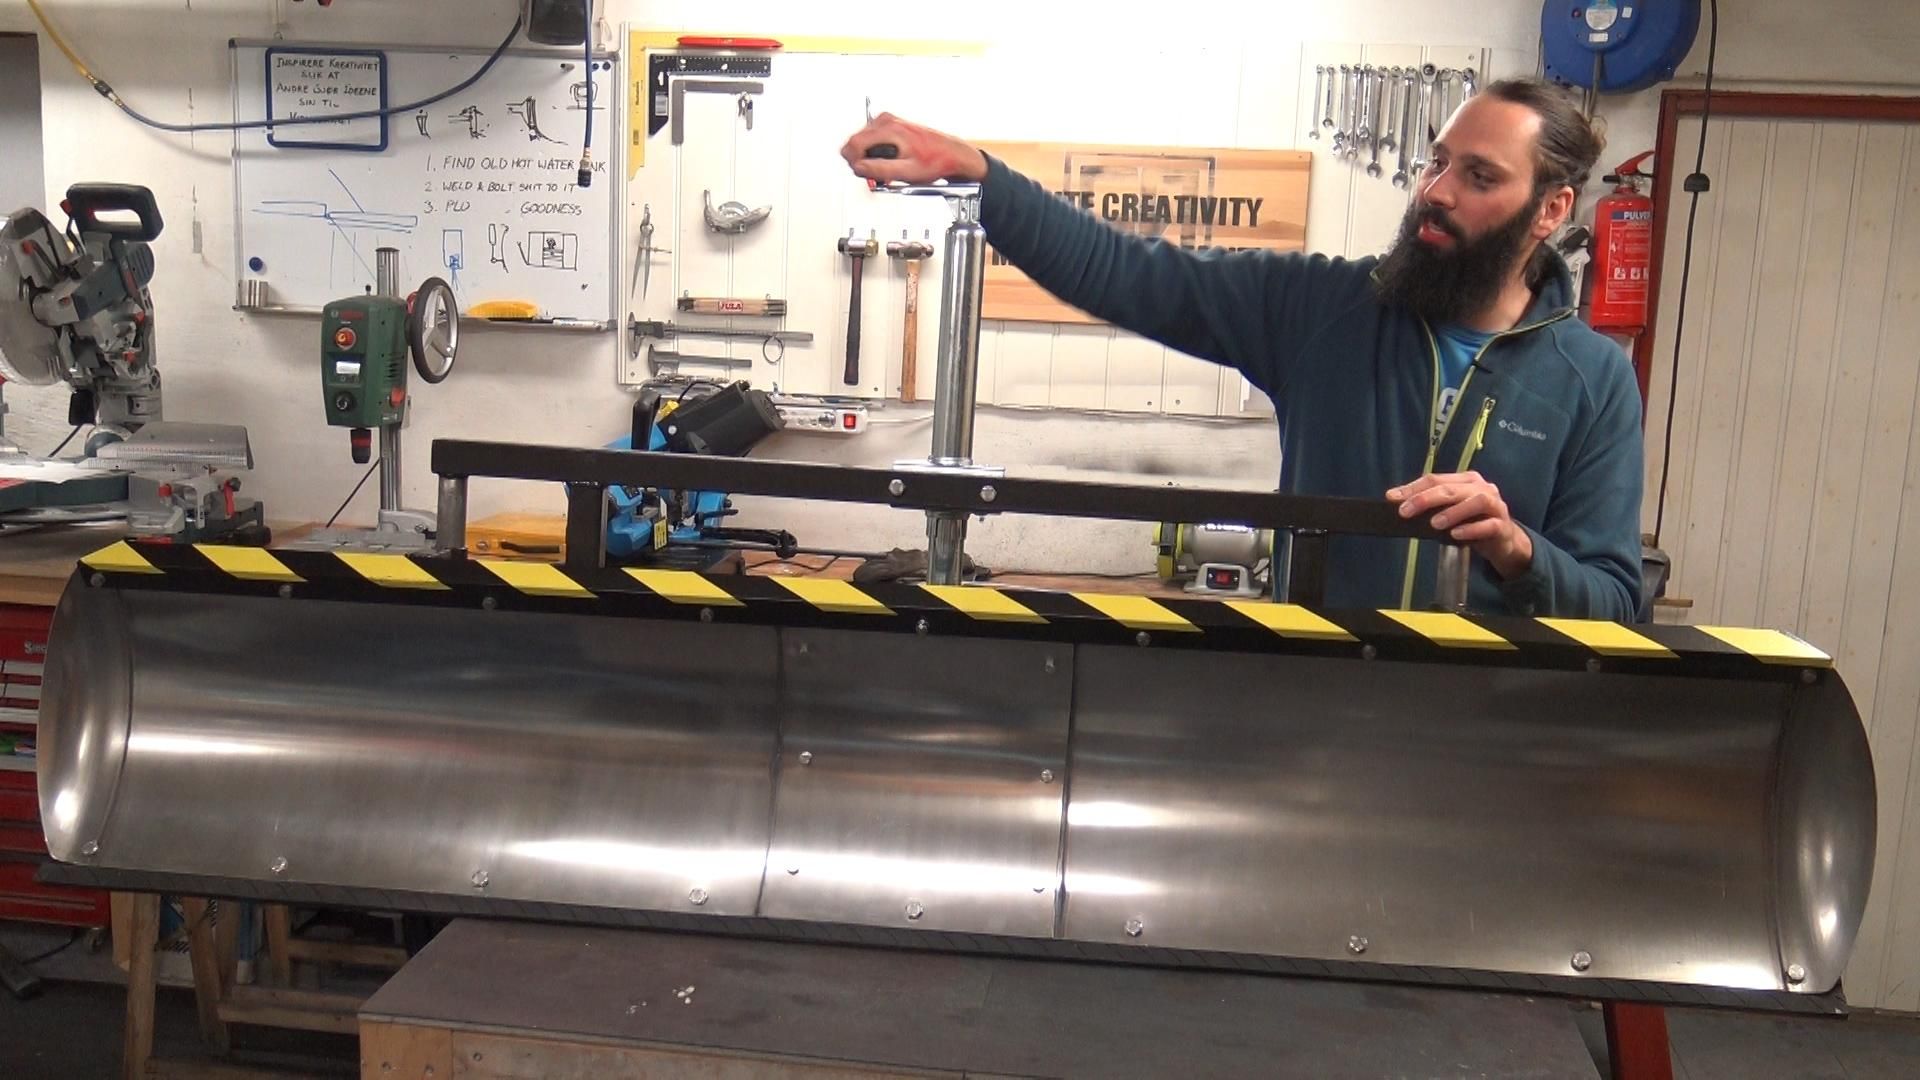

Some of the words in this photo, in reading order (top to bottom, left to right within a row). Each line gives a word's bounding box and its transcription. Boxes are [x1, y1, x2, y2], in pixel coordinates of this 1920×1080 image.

[328, 71, 341, 80] AT
[443, 156, 476, 170] FIND
[480, 157, 509, 170] OLD
[511, 157, 533, 170] HOT
[537, 159, 575, 170] WATER
[443, 183, 473, 192] WELD
[477, 183, 484, 192] &
[487, 183, 513, 192] BOLT
[519, 183, 543, 192] SHIT
[545, 183, 558, 192] TO
[563, 183, 577, 194] IT
[520, 201, 583, 216] GOODNESS
[1102, 192, 1264, 227] CREATIVITY
